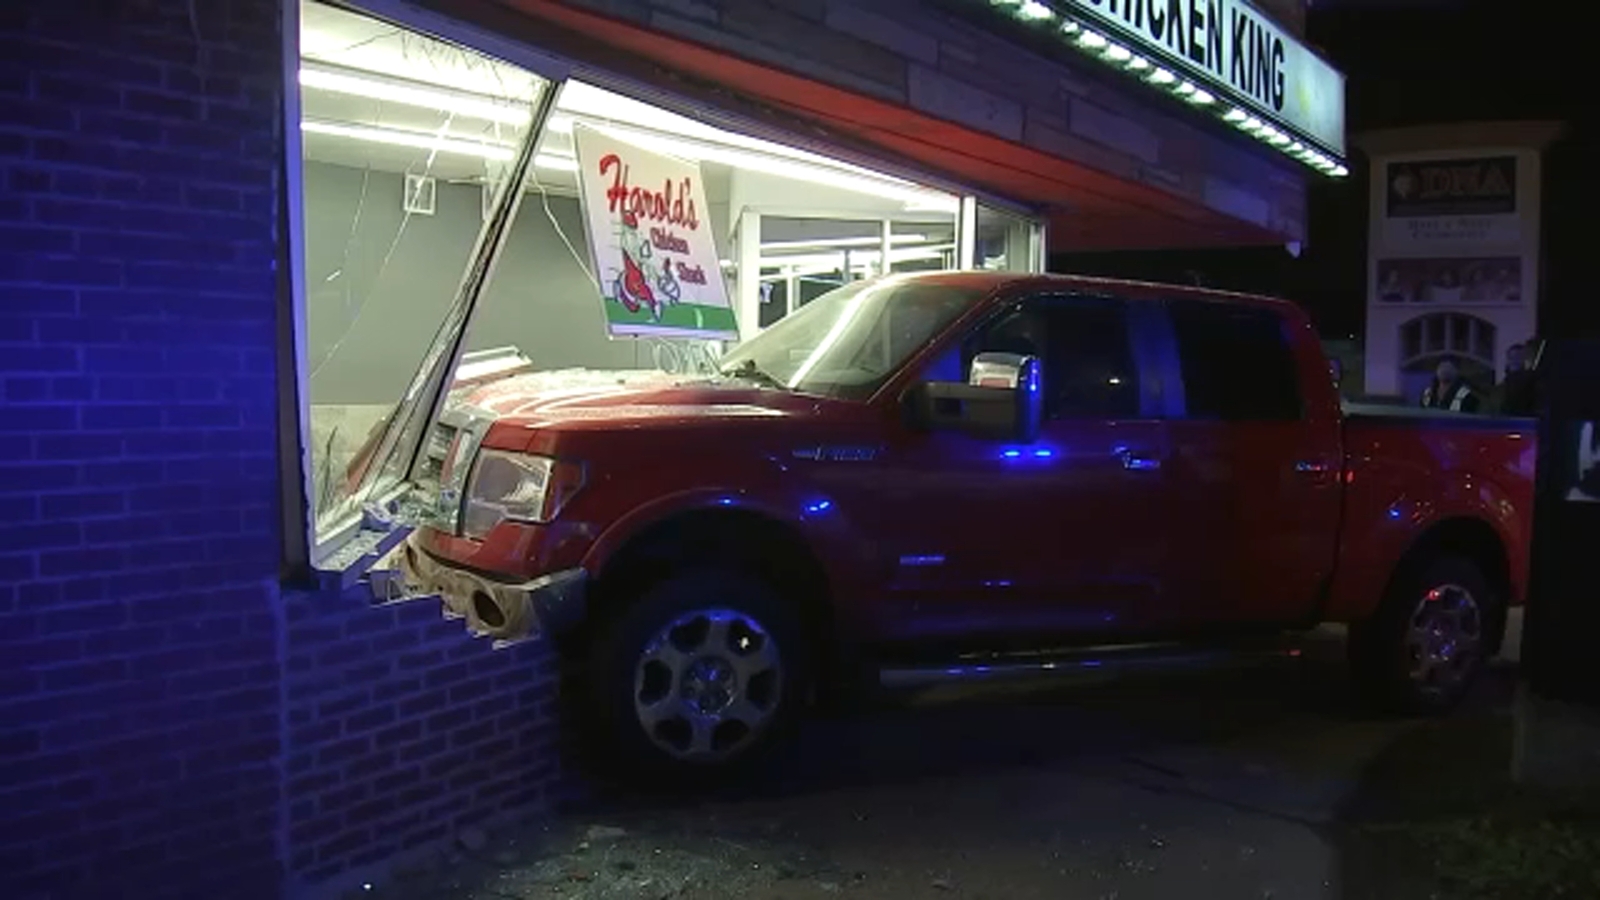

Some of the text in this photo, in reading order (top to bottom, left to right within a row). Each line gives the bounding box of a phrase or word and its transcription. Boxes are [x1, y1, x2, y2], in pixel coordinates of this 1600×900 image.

[1089, 0, 1285, 112] CKEN KING
[599, 154, 700, 230] Harold's
[650, 227, 690, 255] Chicken
